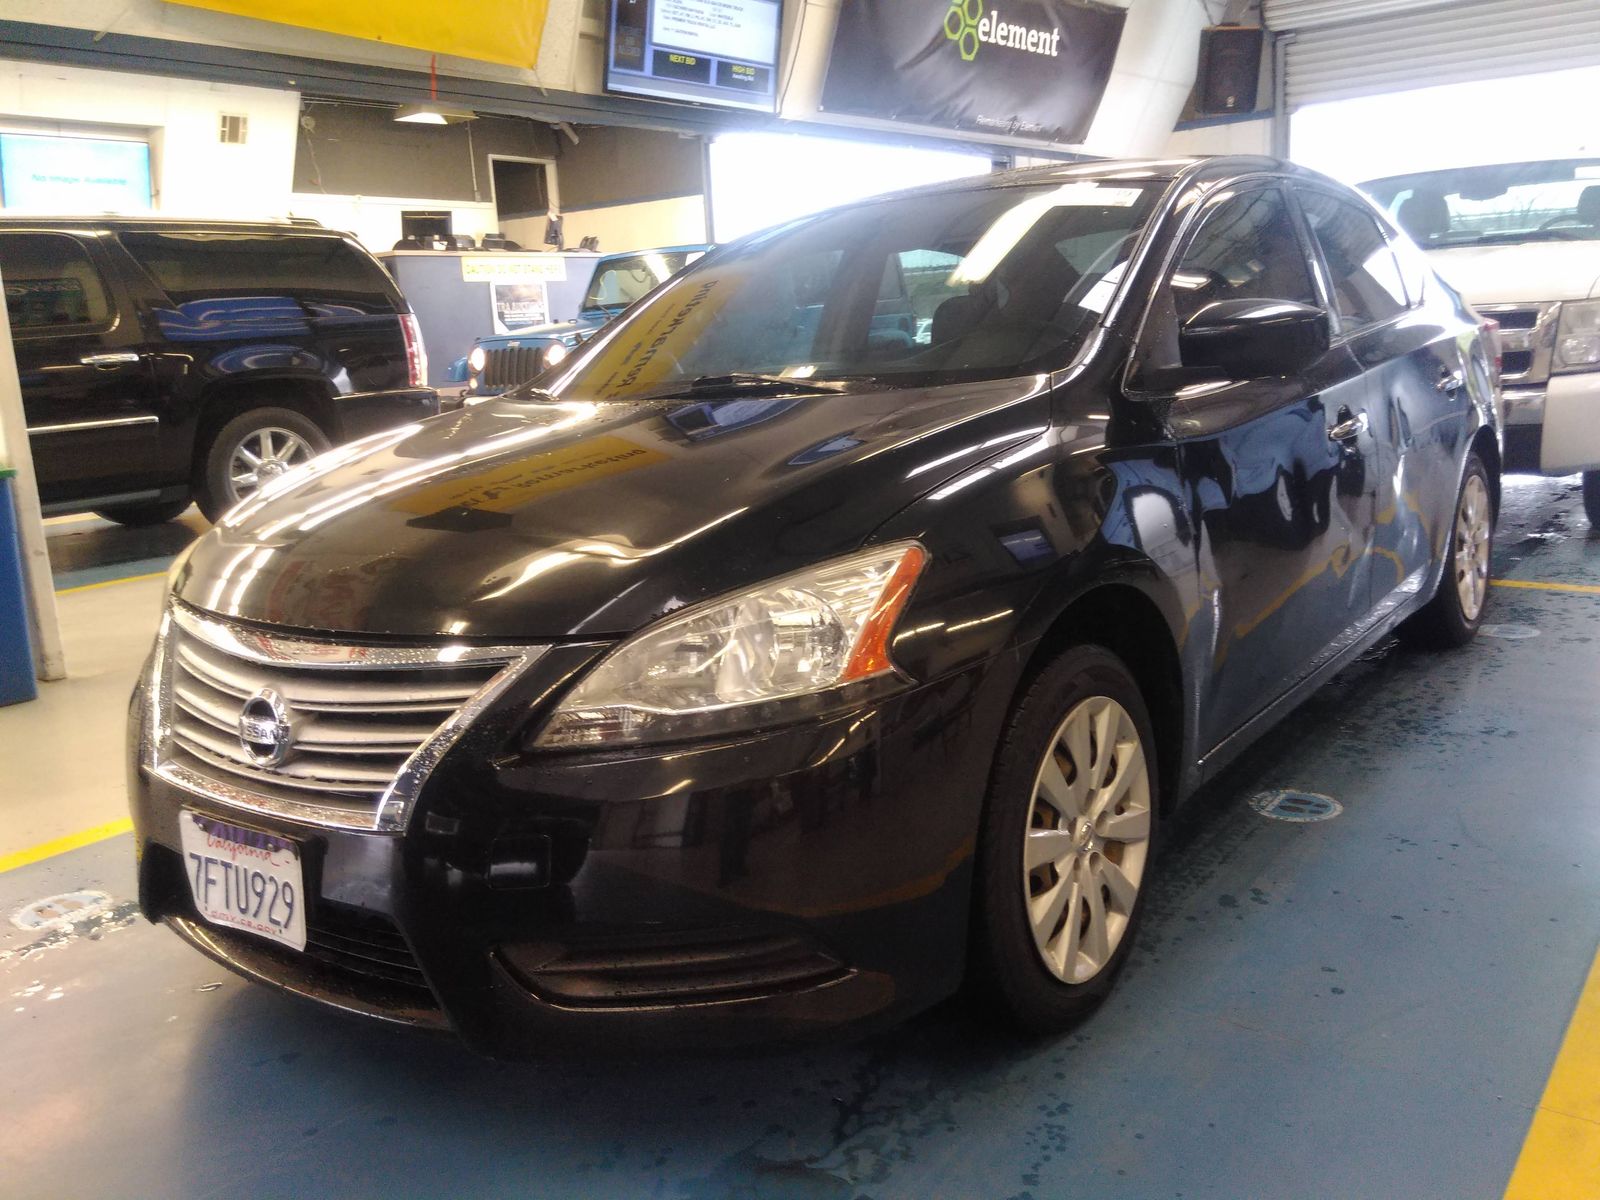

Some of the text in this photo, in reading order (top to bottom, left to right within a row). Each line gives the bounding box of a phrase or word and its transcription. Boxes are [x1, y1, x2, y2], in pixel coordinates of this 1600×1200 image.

[978, 10, 1060, 57] element
[669, 54, 684, 64] NEXT
[243, 723, 284, 742] SSAN
[190, 852, 294, 929] 7FTU929
